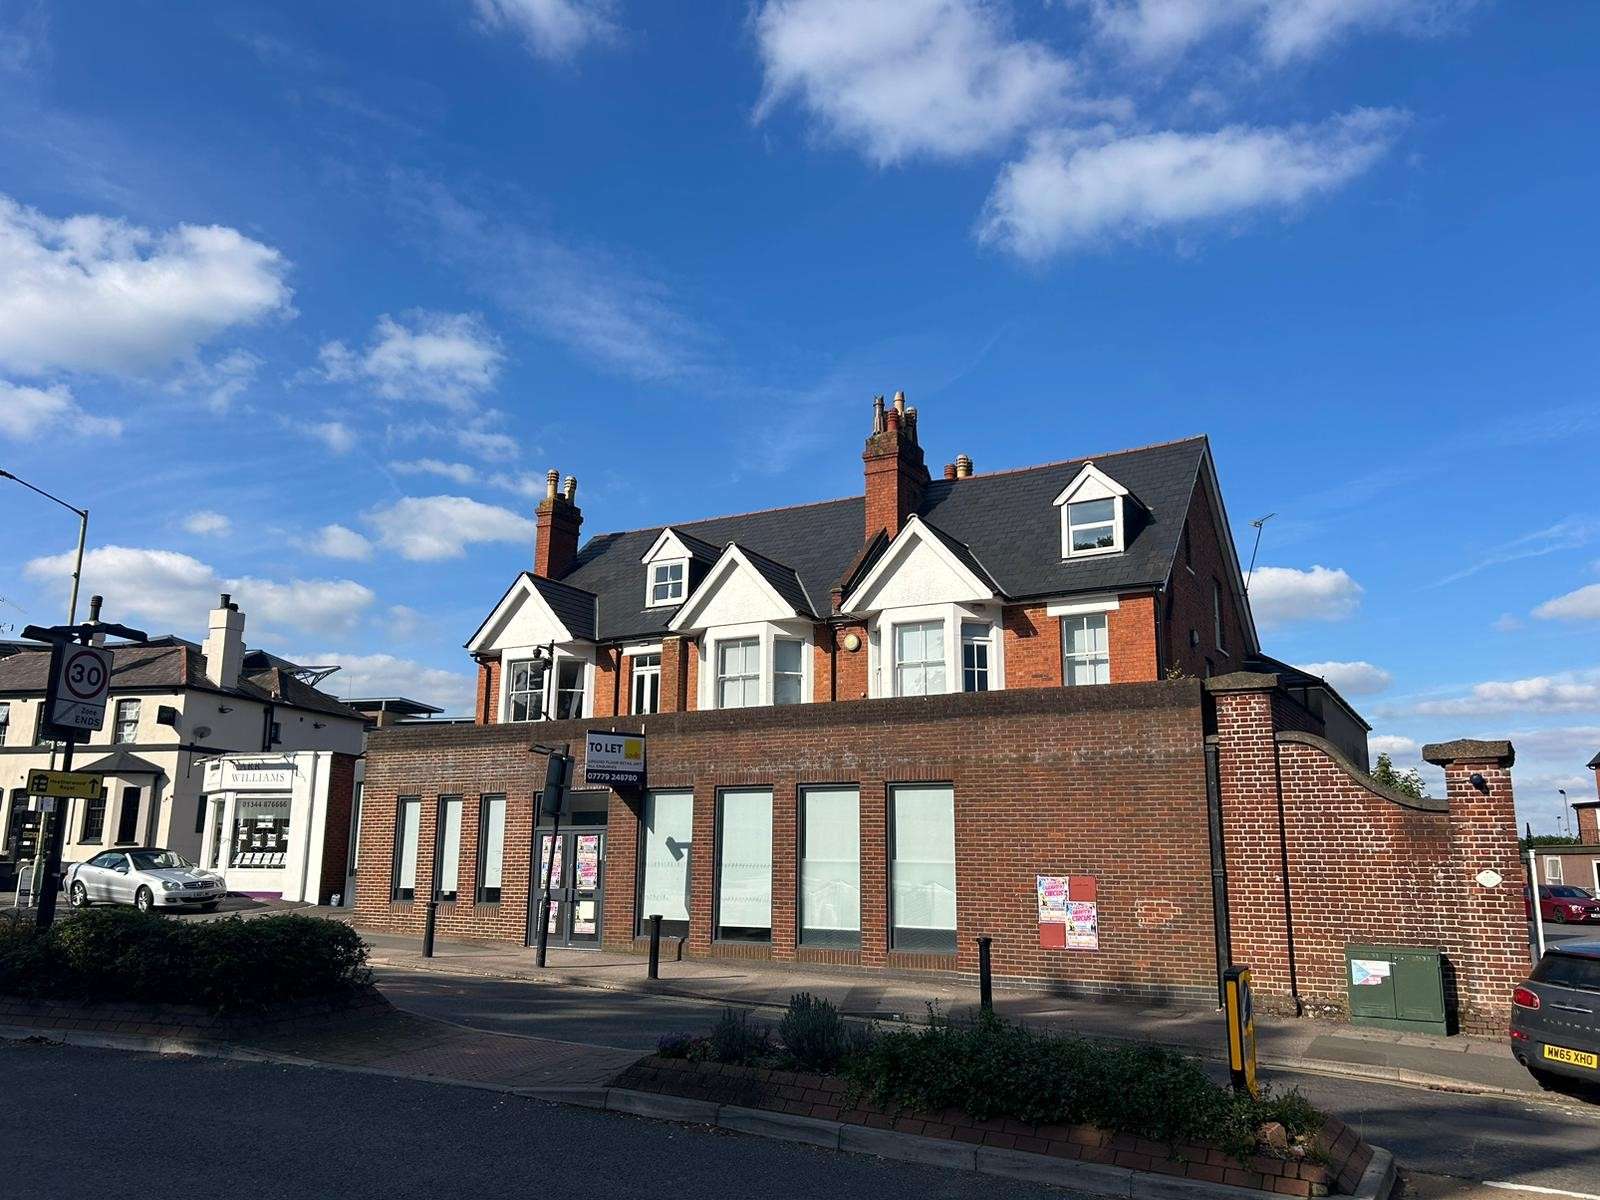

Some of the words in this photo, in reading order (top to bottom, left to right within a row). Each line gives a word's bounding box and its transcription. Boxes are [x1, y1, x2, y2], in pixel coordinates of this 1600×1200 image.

[70, 663, 101, 686] 30
[75, 716, 101, 727] ENDS
[589, 742, 603, 752] TO
[605, 743, 623, 754] LET
[231, 773, 285, 783] WILLIAMS
[242, 800, 261, 808] 01344
[1573, 1051, 1592, 1065] XHO
